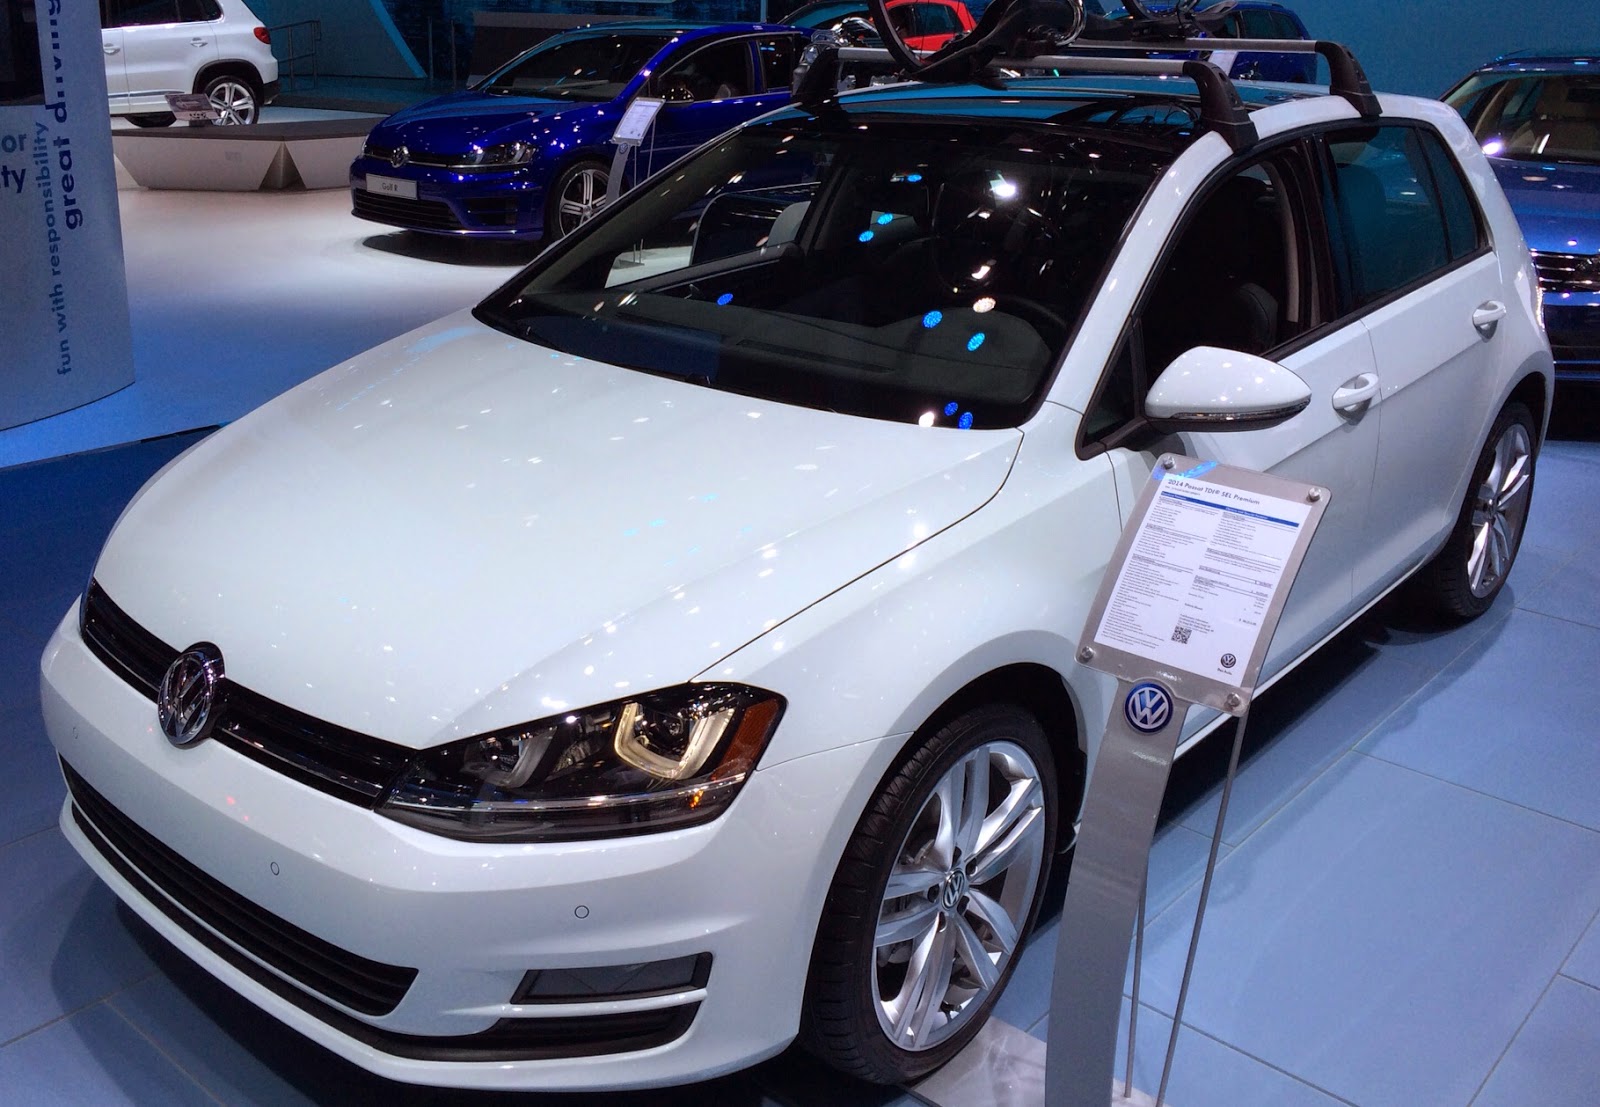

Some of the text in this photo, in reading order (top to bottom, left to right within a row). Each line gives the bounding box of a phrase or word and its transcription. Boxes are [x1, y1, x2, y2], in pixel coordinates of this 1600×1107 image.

[0, 165, 27, 194] ty
[53, 135, 84, 230] great
[33, 122, 71, 376] fun with responsibility
[1168, 479, 1184, 487] 2014
[1184, 482, 1204, 492] Passat
[1233, 494, 1260, 505] Premium
[1128, 685, 1170, 729] VW
